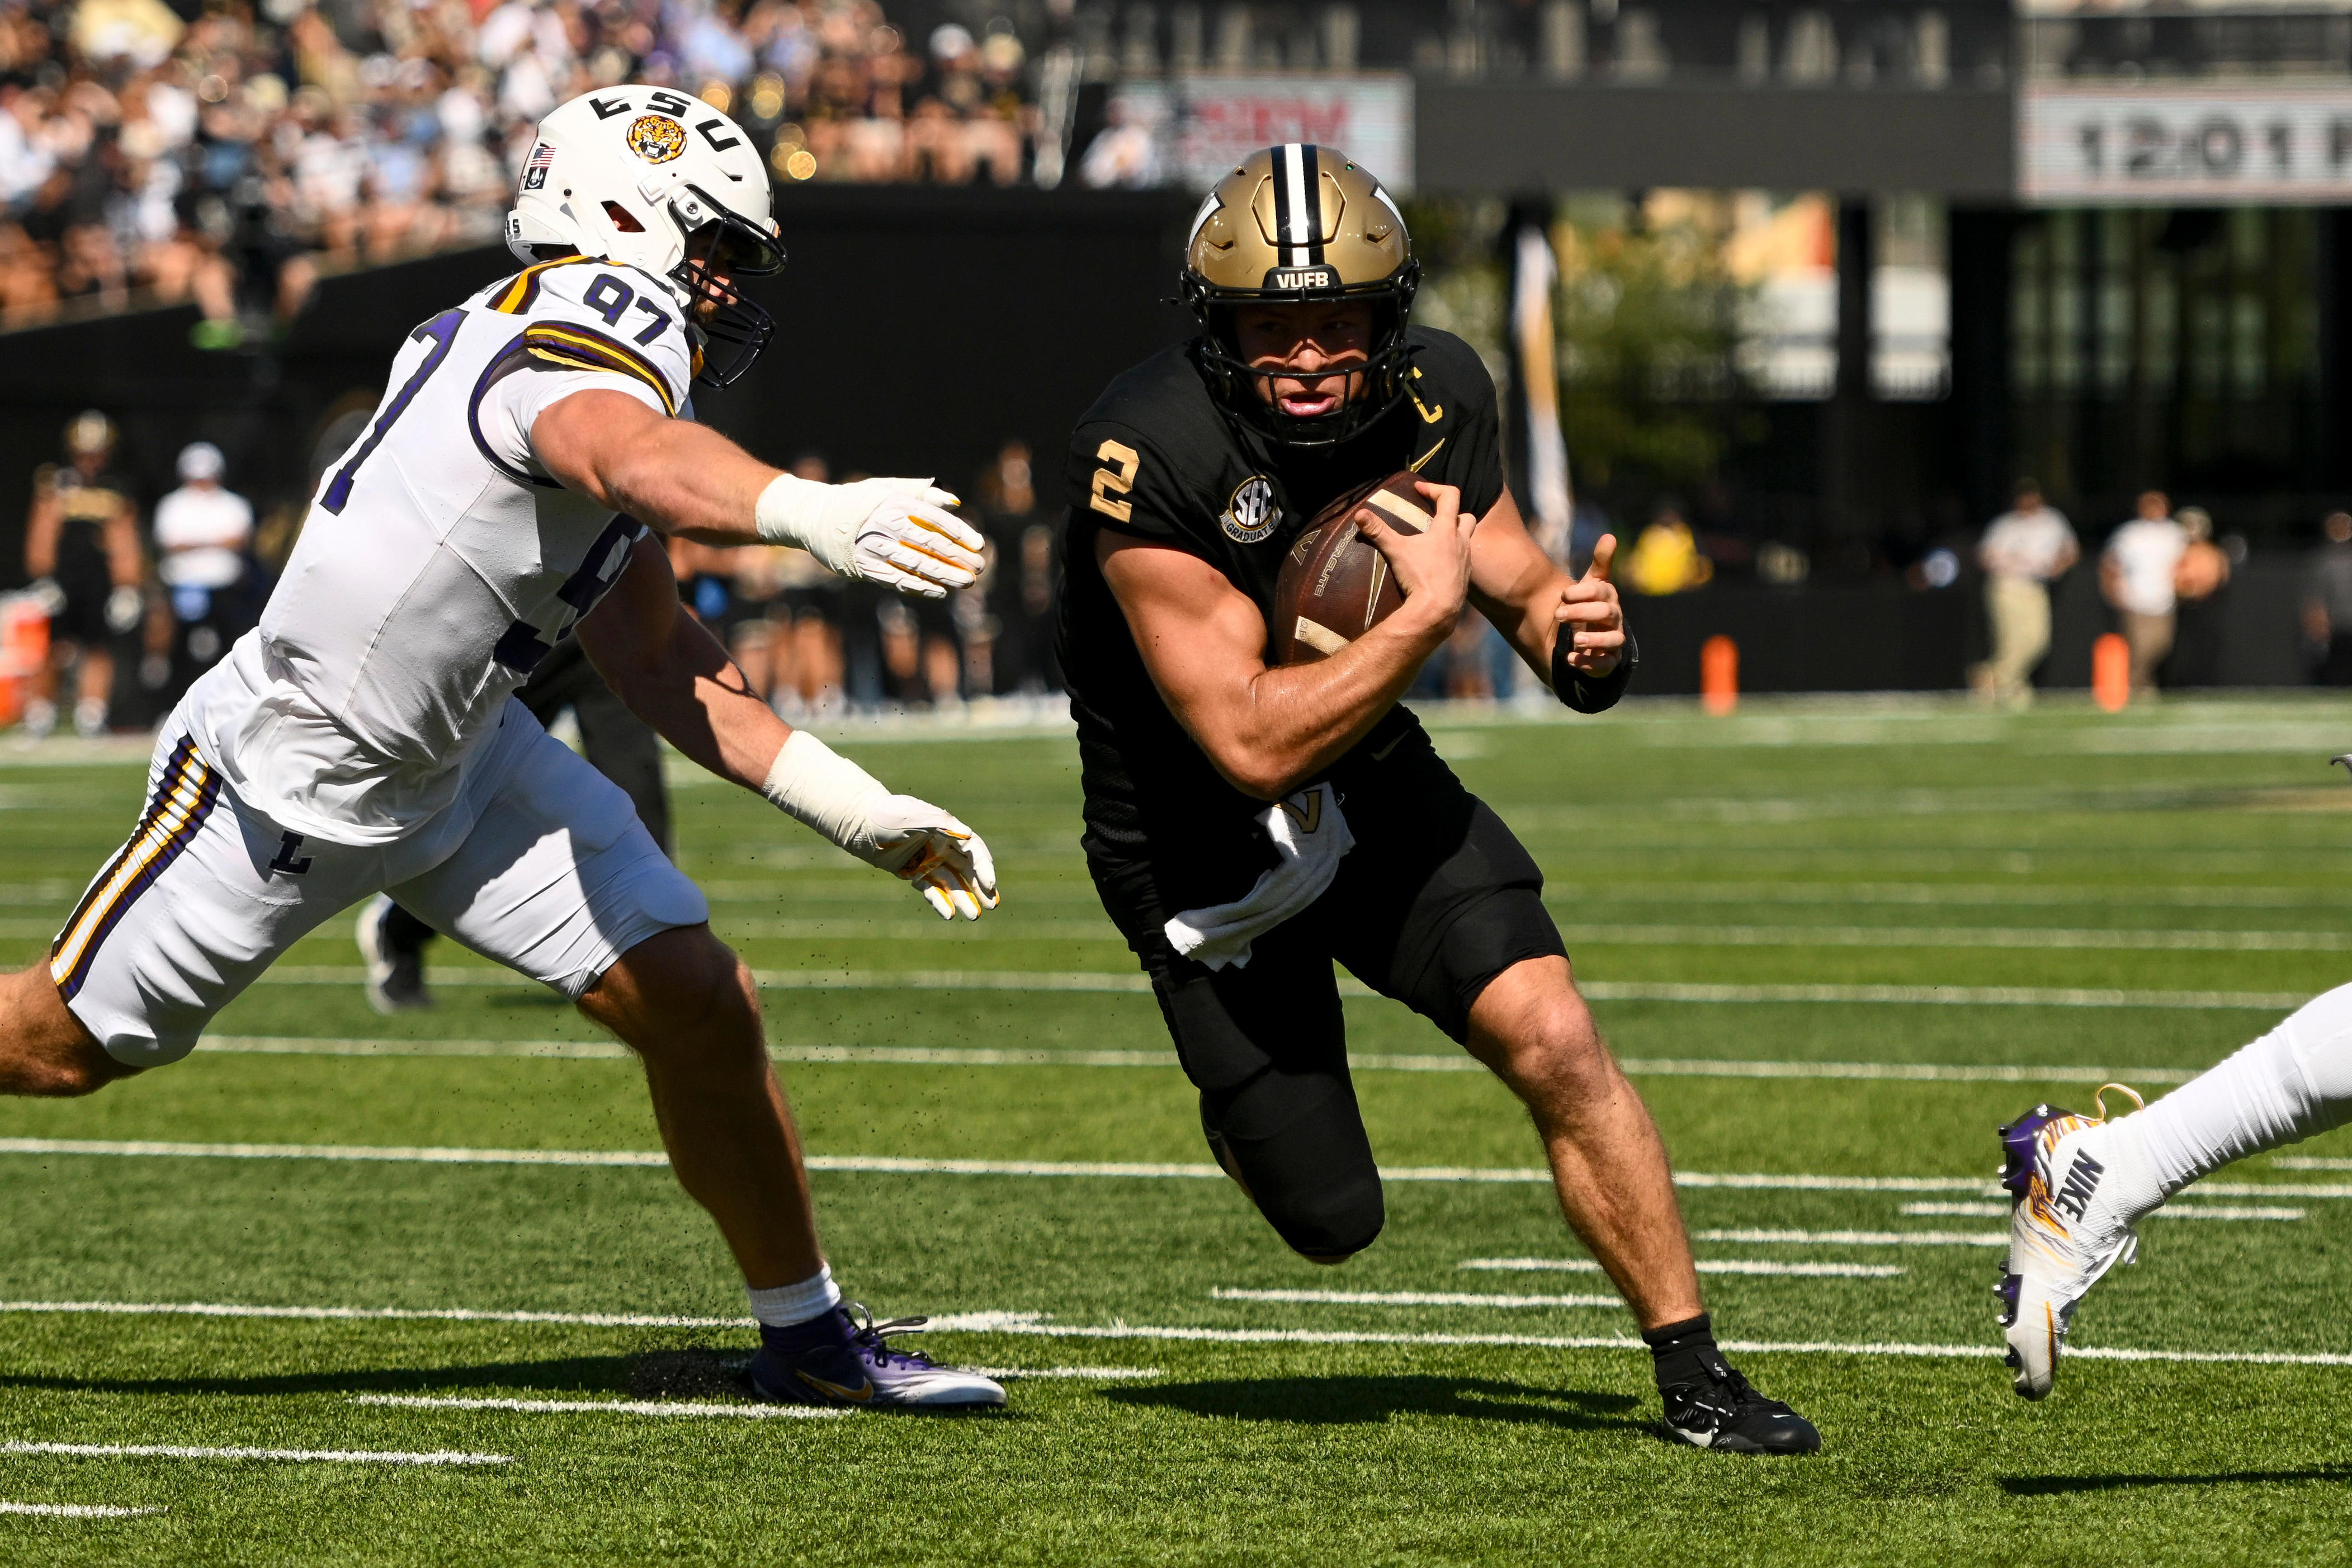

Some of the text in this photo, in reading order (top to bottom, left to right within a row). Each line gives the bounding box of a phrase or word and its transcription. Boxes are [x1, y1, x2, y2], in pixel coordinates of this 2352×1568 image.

[589, 92, 741, 153] LSU
[1276, 272, 1329, 289] VUFB
[583, 273, 673, 346] 97
[1090, 438, 1140, 523] 2
[1234, 480, 1272, 526] SEC
[1226, 522, 1276, 542] GRADUATE
[268, 830, 313, 875] L
[2053, 1147, 2105, 1224] NIKE
